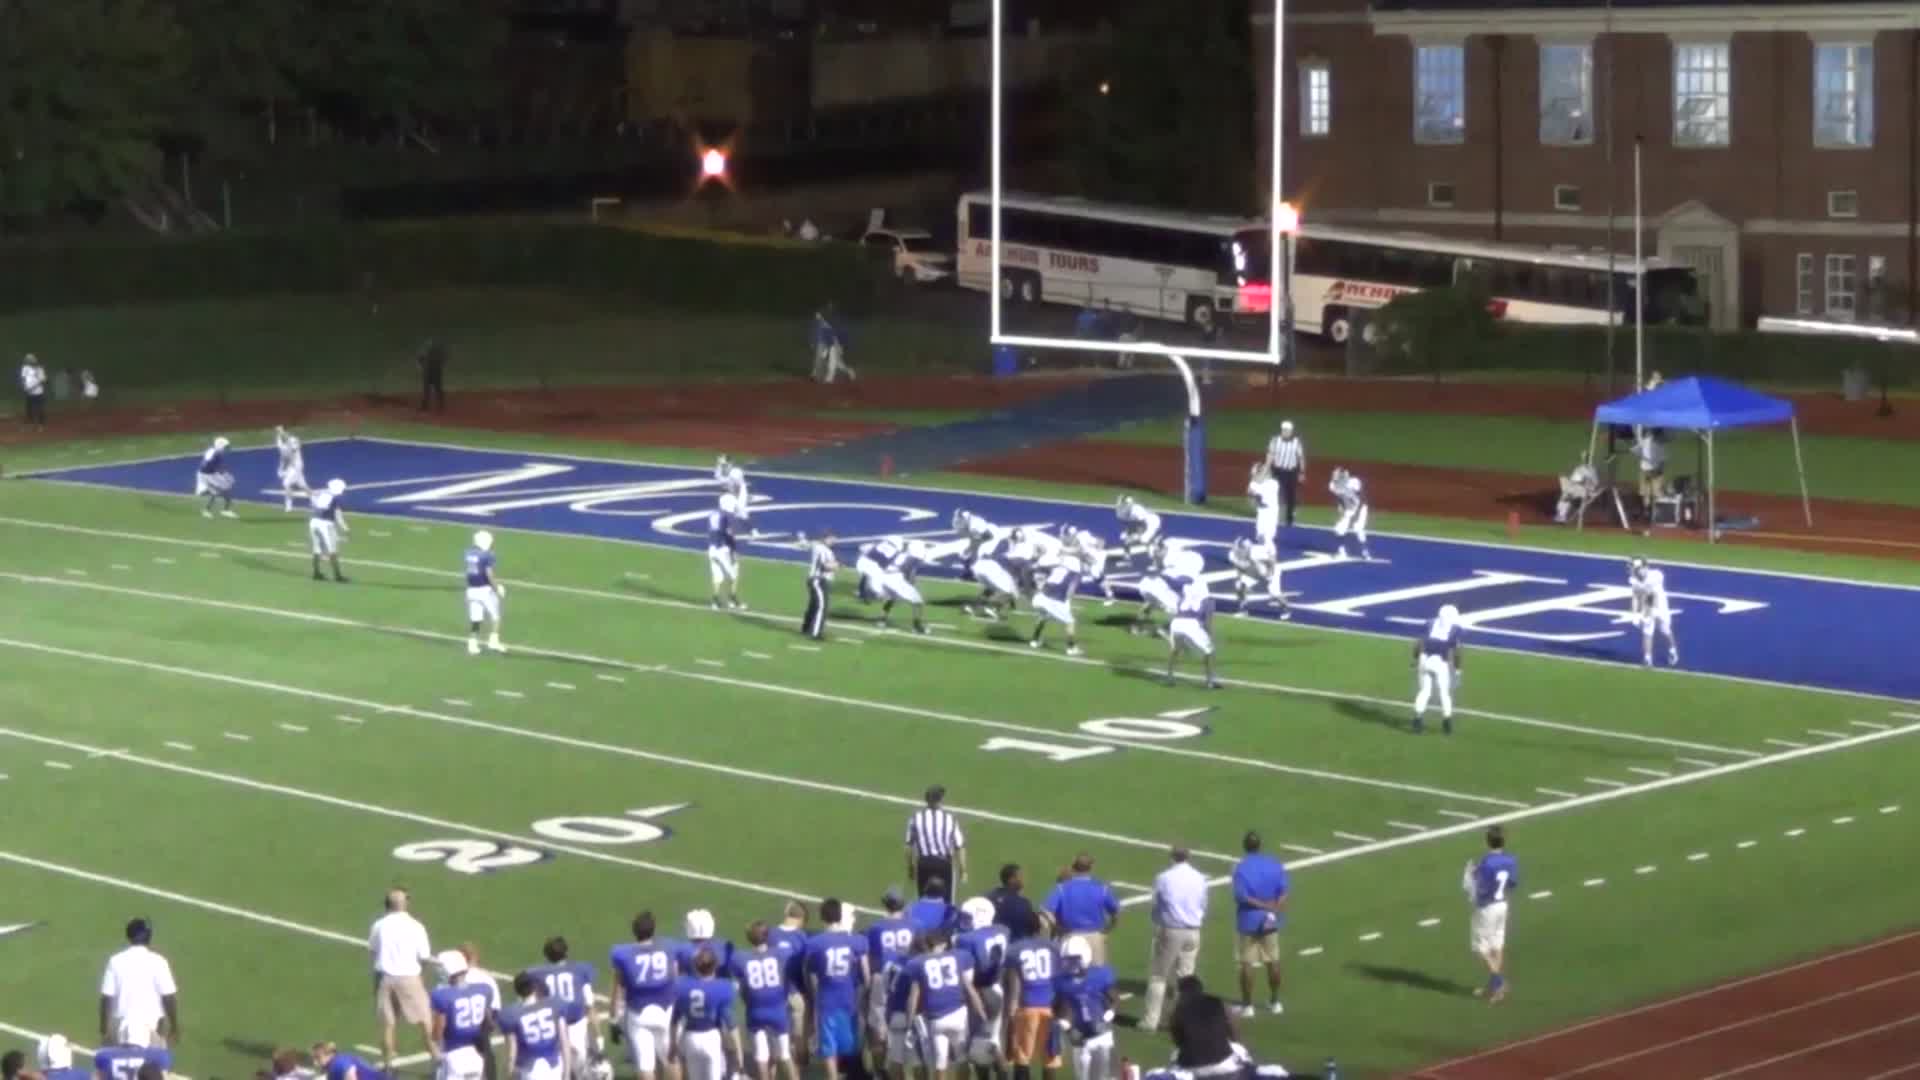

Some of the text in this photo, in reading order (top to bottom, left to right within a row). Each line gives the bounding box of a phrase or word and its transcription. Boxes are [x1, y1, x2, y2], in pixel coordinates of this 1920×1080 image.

[1049, 252, 1100, 273] TOURS
[979, 715, 1206, 763] 10
[391, 813, 670, 875] 20
[635, 950, 669, 984] 79
[746, 956, 781, 990] 88
[825, 946, 851, 977] 15
[923, 955, 960, 990] 83
[1019, 948, 1052, 981] 20
[544, 971, 575, 1002] 10
[689, 988, 705, 1018] 2
[454, 993, 487, 1029] 28
[520, 1007, 557, 1045] 55
